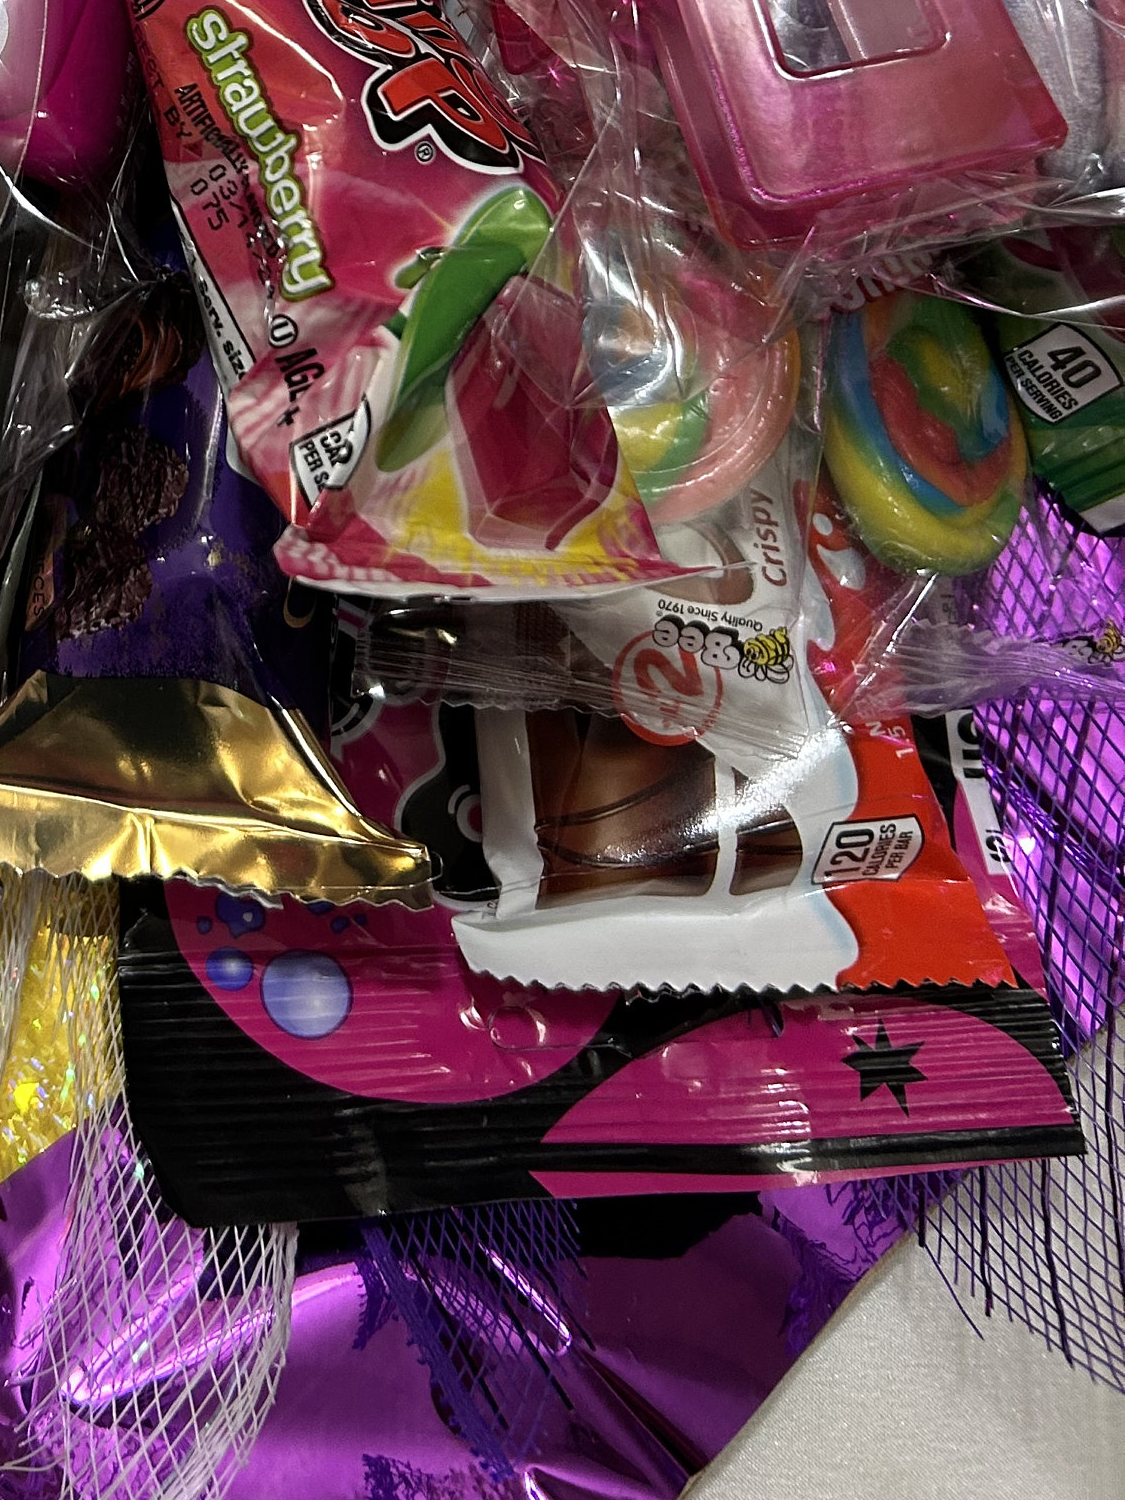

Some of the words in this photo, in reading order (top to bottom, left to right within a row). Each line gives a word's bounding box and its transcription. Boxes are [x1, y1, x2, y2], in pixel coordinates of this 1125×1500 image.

[163, 105, 193, 140] BY
[190, 11, 333, 295] strawberry
[190, 178, 230, 232] 075
[1005, 356, 1025, 380] PER
[1020, 377, 1064, 421] SERVING
[1017, 349, 1079, 411] CALORIES
[1047, 346, 1102, 389] 40
[297, 439, 324, 478] PER
[750, 487, 788, 588] Crispy
[657, 599, 686, 615] 1970
[686, 604, 719, 622] Since
[719, 610, 764, 632] Quality
[652, 614, 744, 671] Bee
[823, 828, 875, 880] 120
[861, 822, 898, 878] CALORIES
[884, 849, 901, 871] PER
[895, 830, 914, 851] BAR
